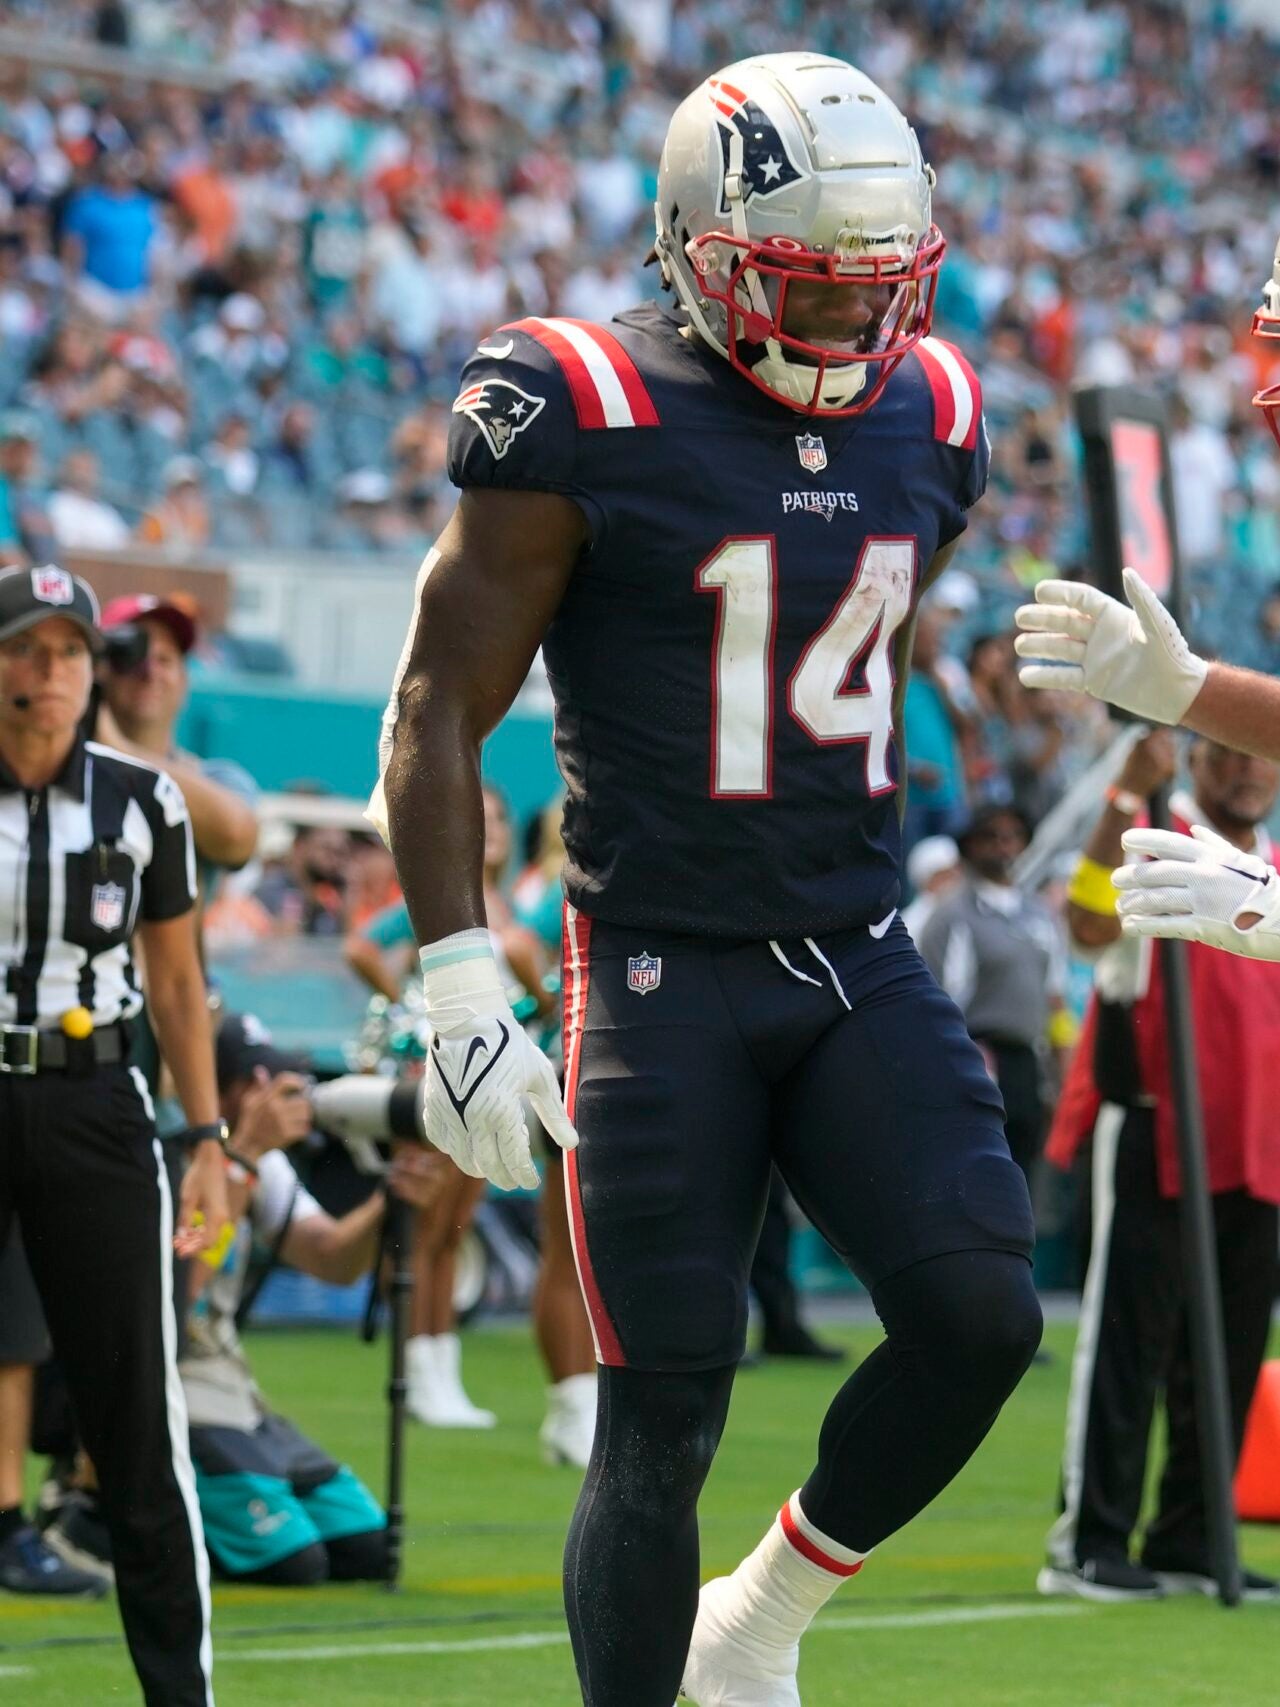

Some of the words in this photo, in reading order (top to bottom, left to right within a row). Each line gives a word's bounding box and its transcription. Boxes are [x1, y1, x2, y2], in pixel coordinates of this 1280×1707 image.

[781, 491, 859, 514] PATRIOTS
[693, 534, 920, 799] 14
[632, 971, 655, 986] NFL
